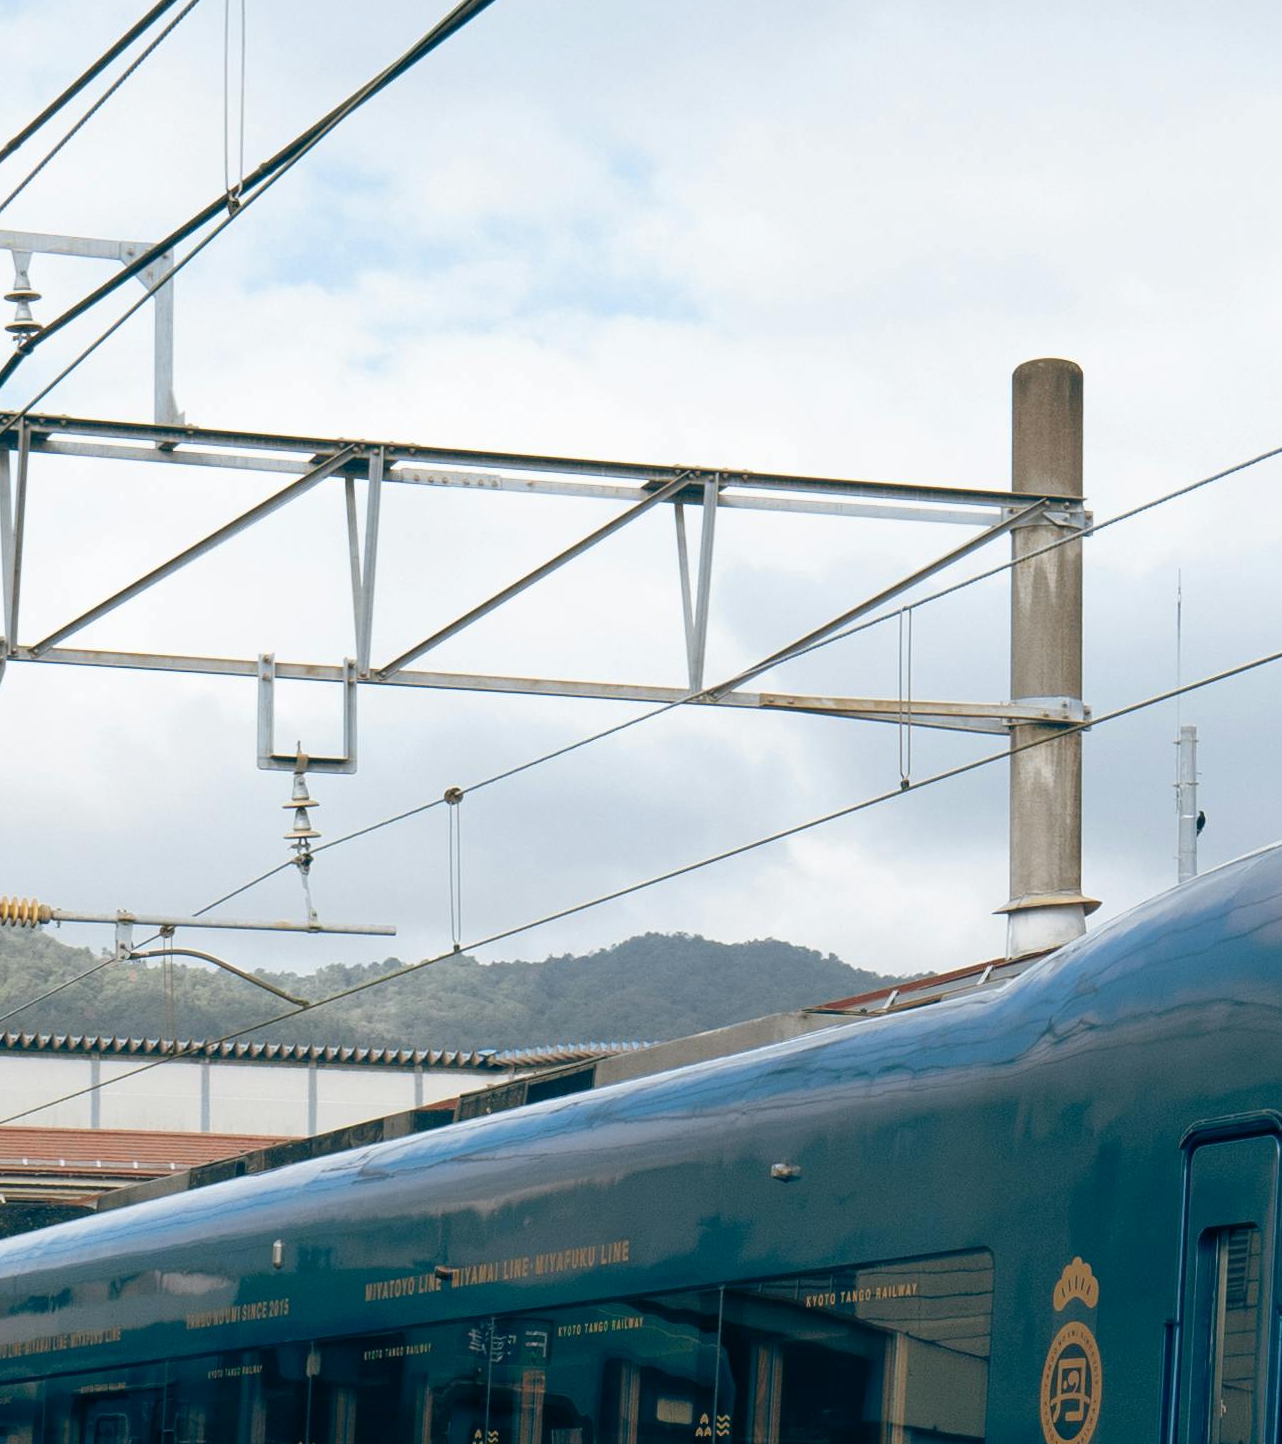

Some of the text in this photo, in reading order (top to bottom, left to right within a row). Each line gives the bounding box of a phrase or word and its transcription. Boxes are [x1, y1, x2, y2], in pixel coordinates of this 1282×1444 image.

[418, 1272, 442, 1294] LINE
[601, 1240, 630, 1265] LINE
[805, 1283, 918, 1308] KYOTO TANGO RAILWAY
[242, 1300, 268, 1322] SINCE
[269, 1298, 290, 1319] 2015
[558, 1322, 581, 1338] KYOTO
[584, 1319, 609, 1334] TANGO
